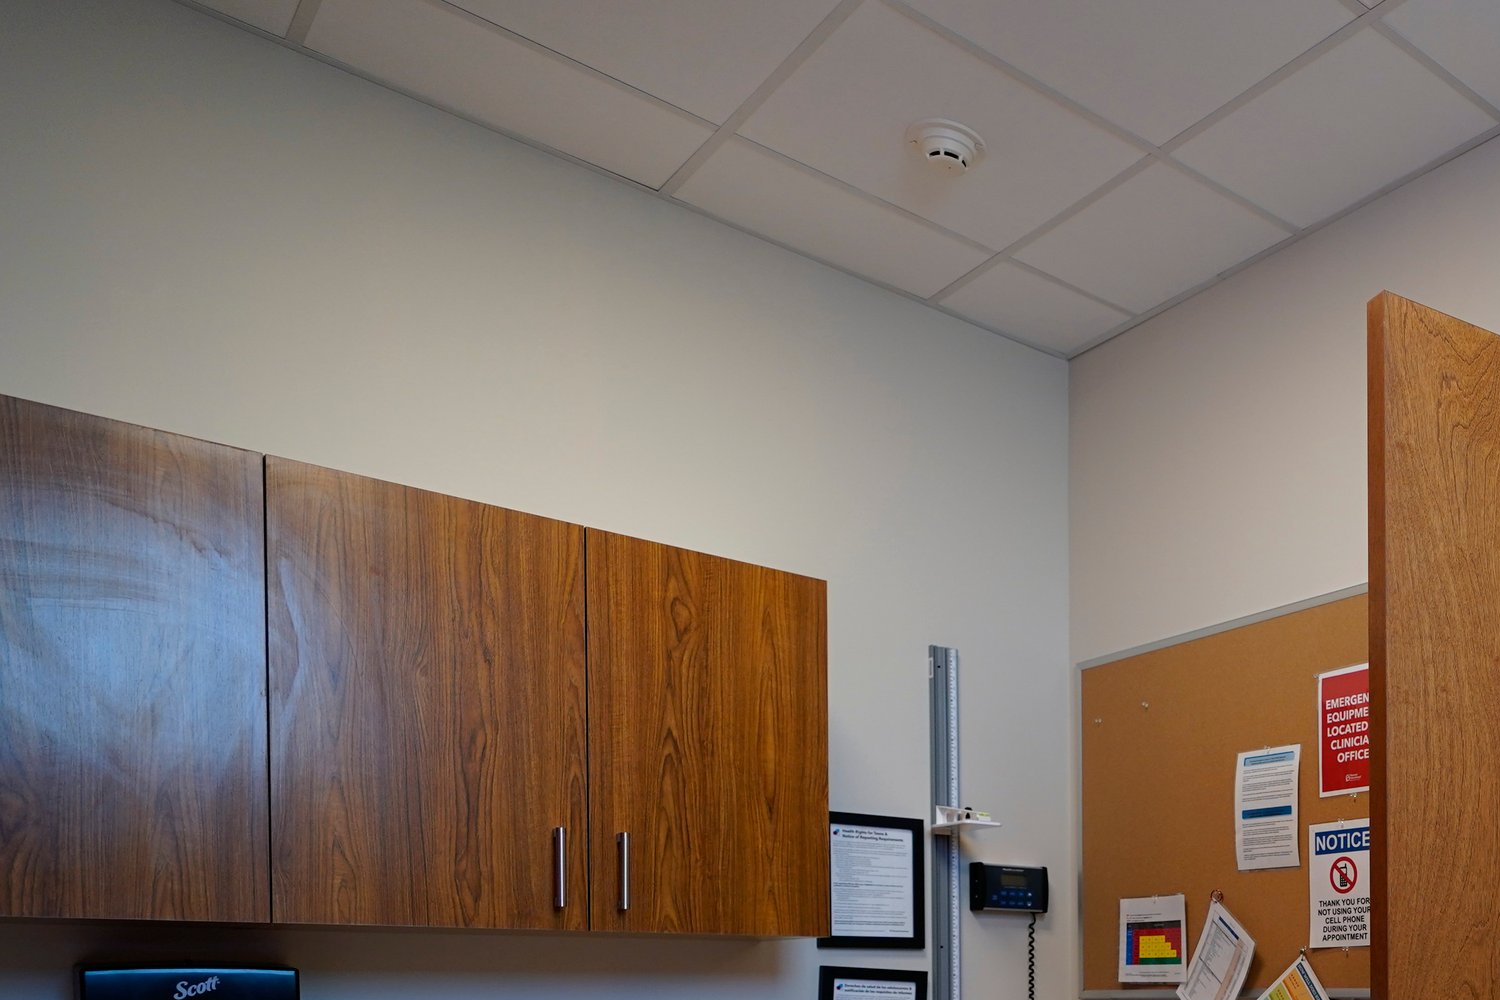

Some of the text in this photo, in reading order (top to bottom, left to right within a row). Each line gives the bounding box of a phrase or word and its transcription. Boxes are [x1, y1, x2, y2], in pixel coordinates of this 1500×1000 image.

[1326, 692, 1369, 710] EMERGEN
[1327, 707, 1369, 724] EQUIPME
[1327, 721, 1368, 737] LOCATED
[1330, 735, 1369, 750] CLINICIA
[1337, 749, 1369, 763] OFFICE
[1316, 831, 1370, 852] NOTICE
[1341, 898, 1355, 906] YOU
[1357, 897, 1370, 905] FOR
[1318, 908, 1331, 916] NOT
[1333, 907, 1352, 915] USING
[1343, 915, 1365, 923] PHONE
[1323, 925, 1348, 933] DURING
[1322, 933, 1368, 941] APPOINTMENT
[173, 976, 218, 1000] Scott
